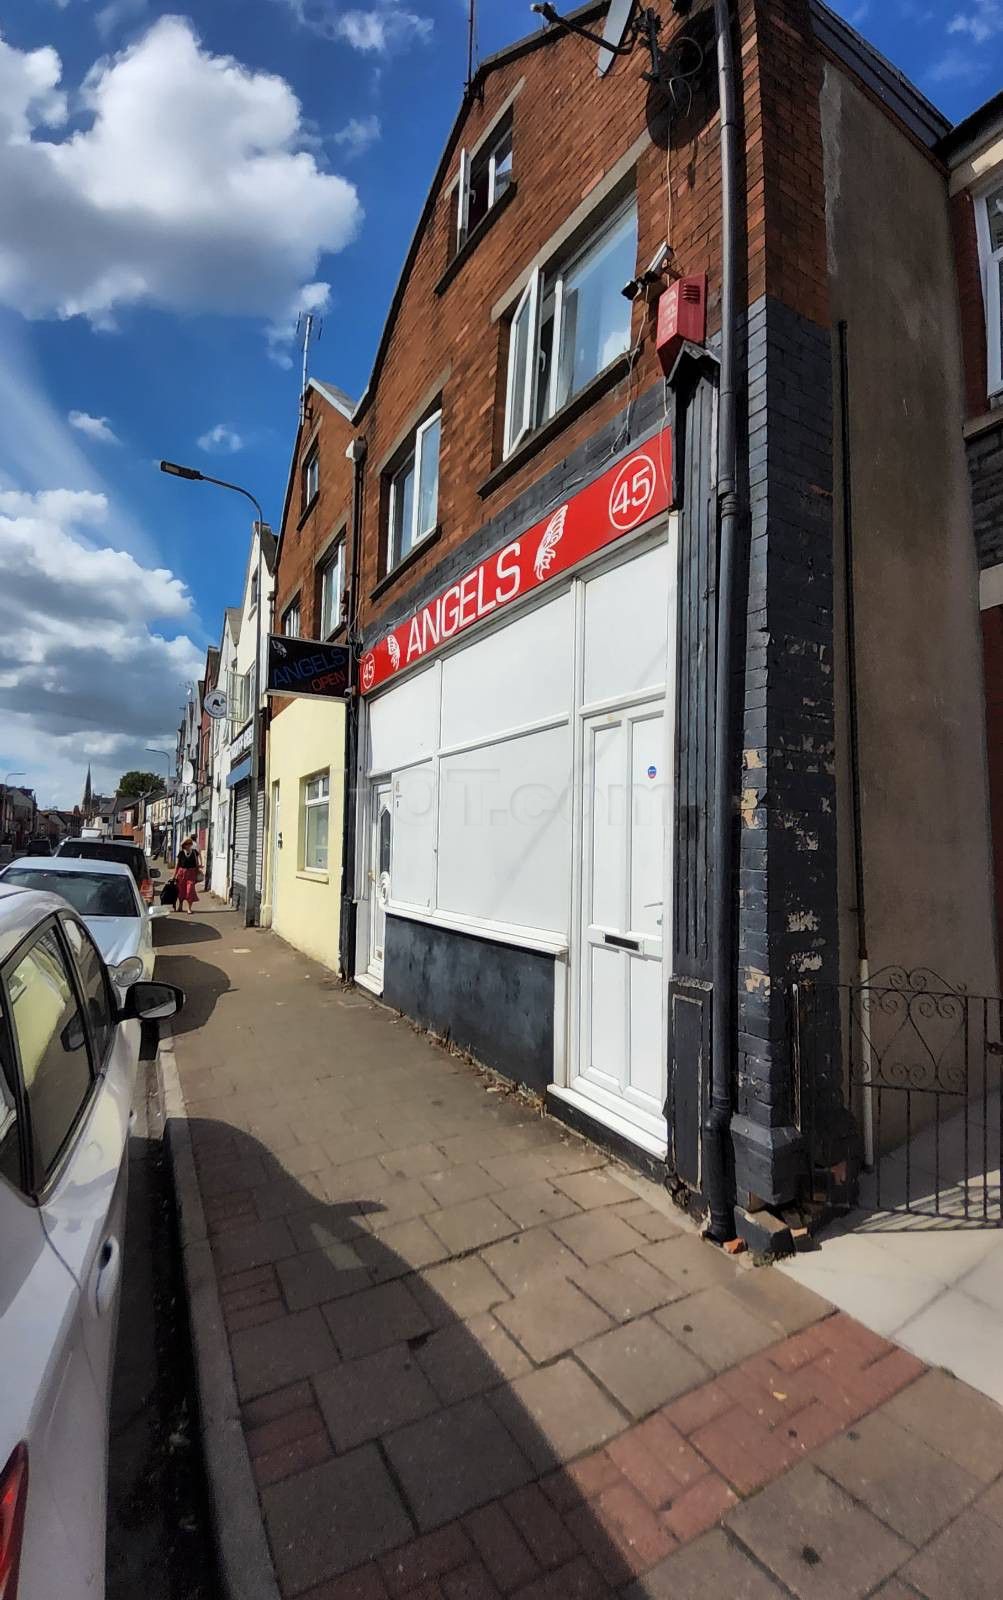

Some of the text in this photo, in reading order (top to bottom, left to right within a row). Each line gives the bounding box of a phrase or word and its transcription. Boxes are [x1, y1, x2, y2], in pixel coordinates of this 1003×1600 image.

[611, 466, 651, 514] 45
[406, 542, 521, 662] ANGELS
[272, 648, 346, 687] ANGELS
[311, 670, 346, 691] OPEN
[363, 663, 374, 681] 45
